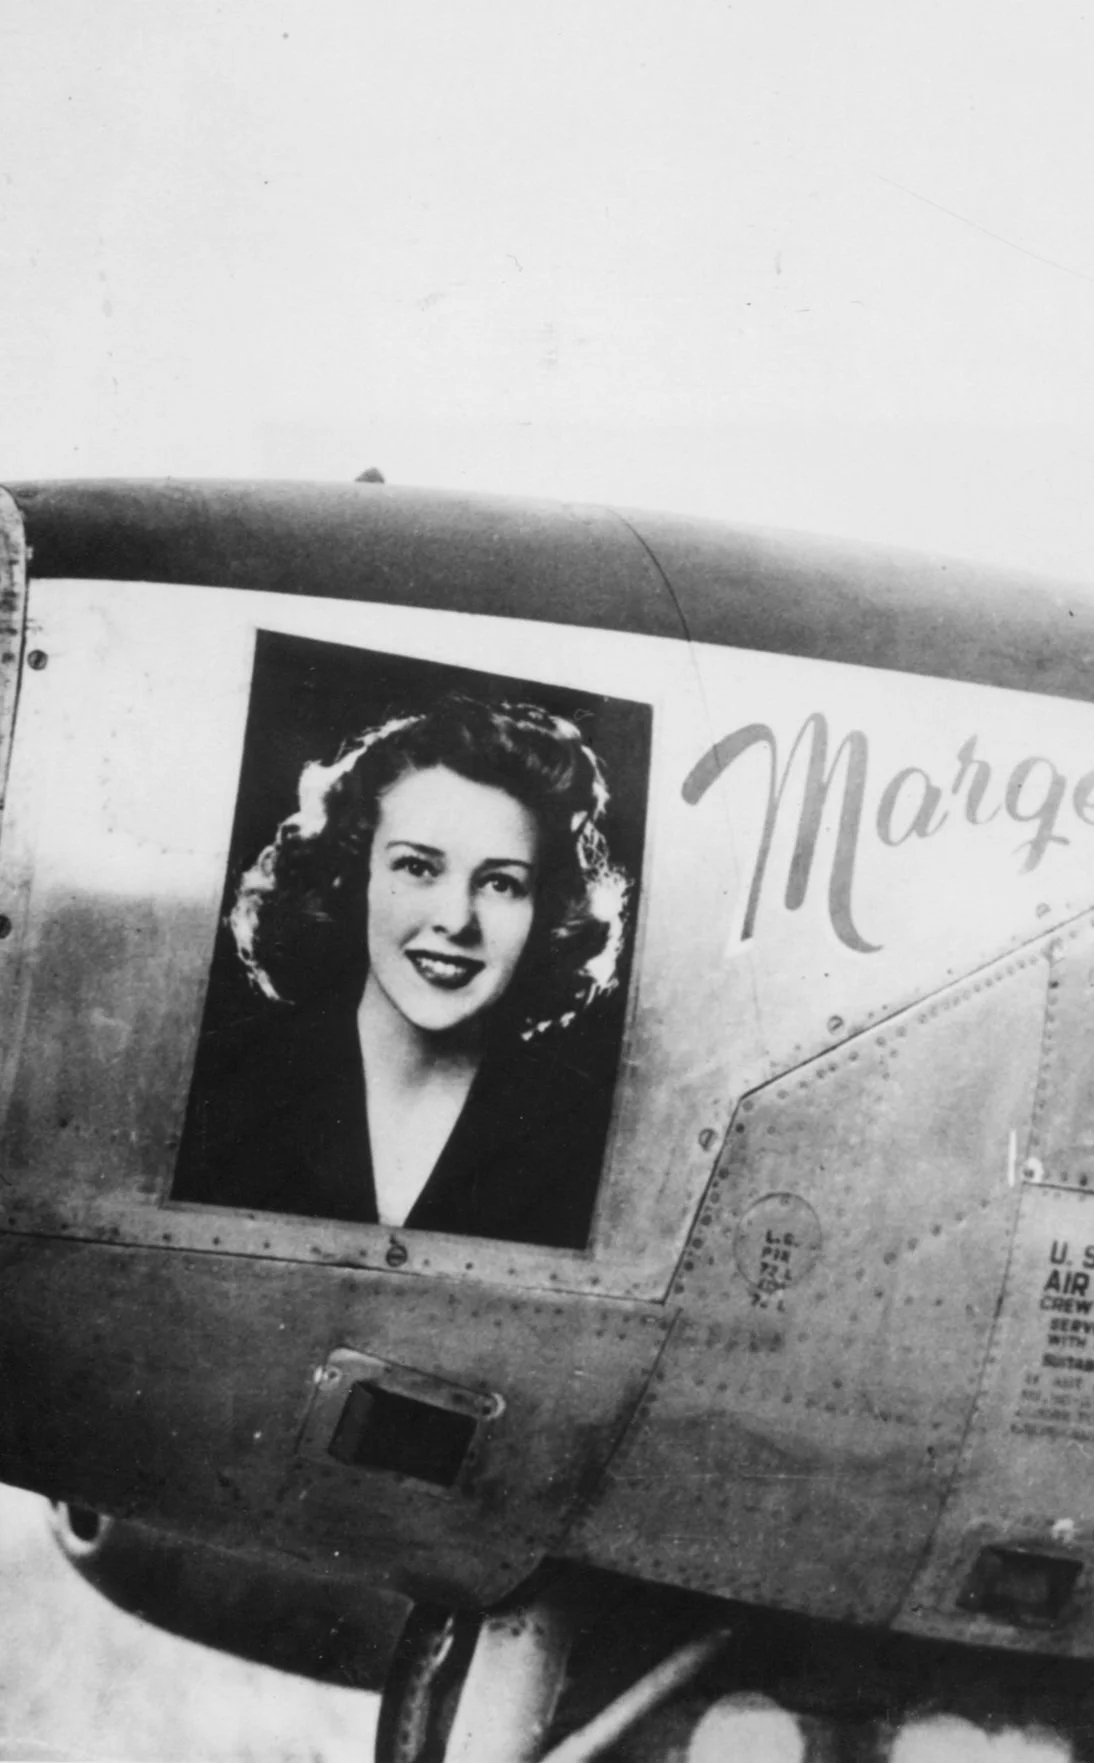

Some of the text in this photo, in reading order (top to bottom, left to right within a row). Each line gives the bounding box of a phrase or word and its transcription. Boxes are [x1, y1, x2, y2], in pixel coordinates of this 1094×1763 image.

[1049, 1240, 1073, 1265] U.
[1044, 1268, 1090, 1297] AIR
[1040, 1295, 1094, 1315] CREW
